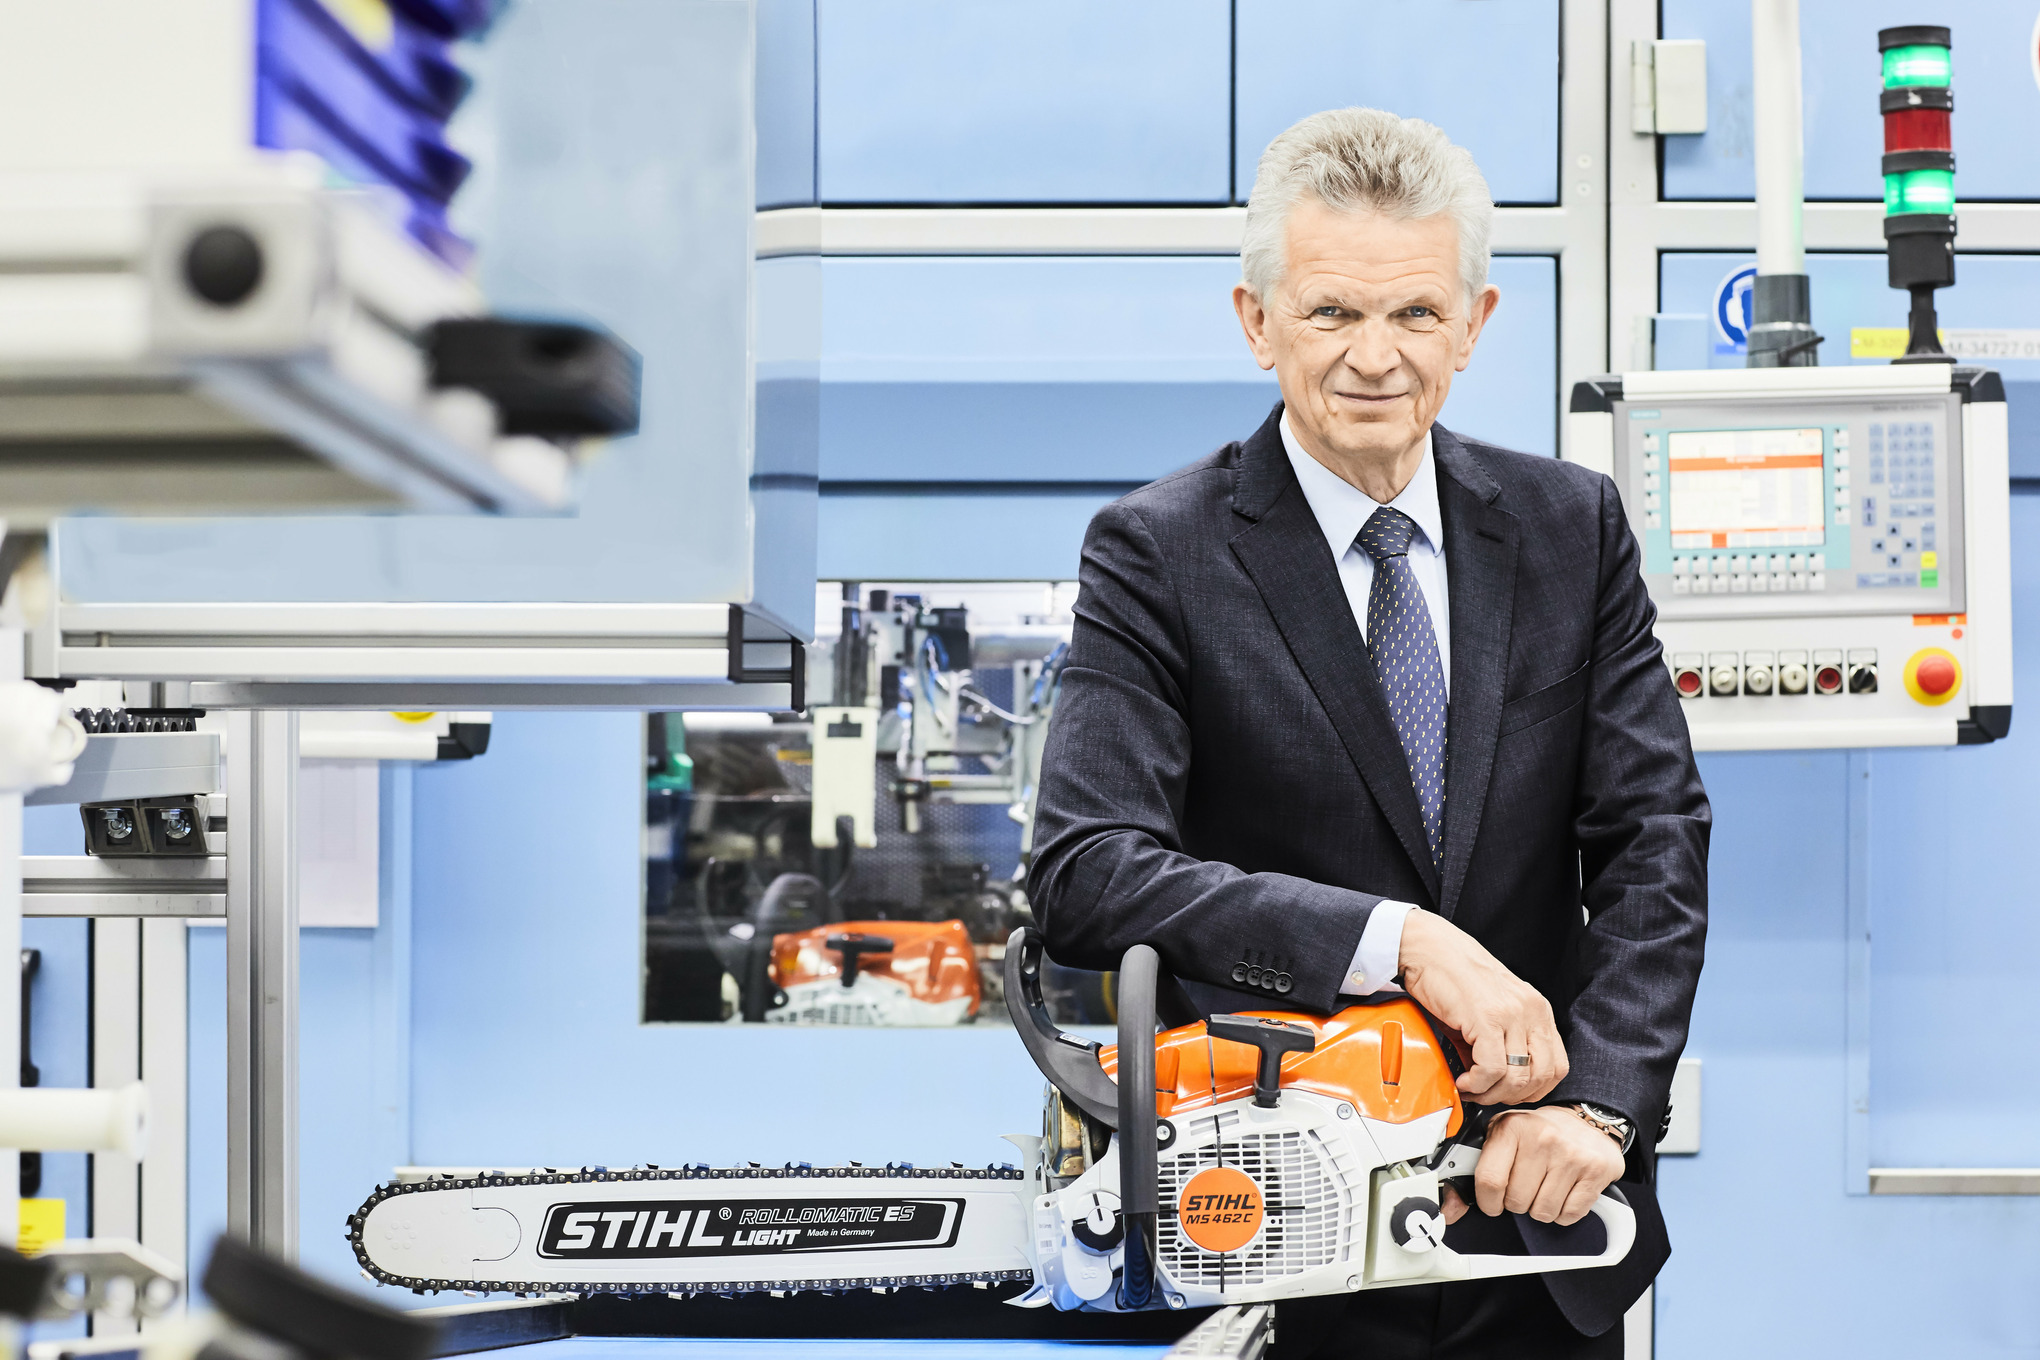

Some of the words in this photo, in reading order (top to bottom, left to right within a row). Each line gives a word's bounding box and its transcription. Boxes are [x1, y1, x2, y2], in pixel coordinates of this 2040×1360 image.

[1186, 1194, 1255, 1211] STIHL
[739, 1206, 883, 1224] ROLLOMATIC
[883, 1206, 916, 1223] ES
[732, 1229, 801, 1246] LIGHT
[807, 1229, 829, 1237] Made
[830, 1229, 838, 1237] in
[840, 1228, 875, 1238] Germany
